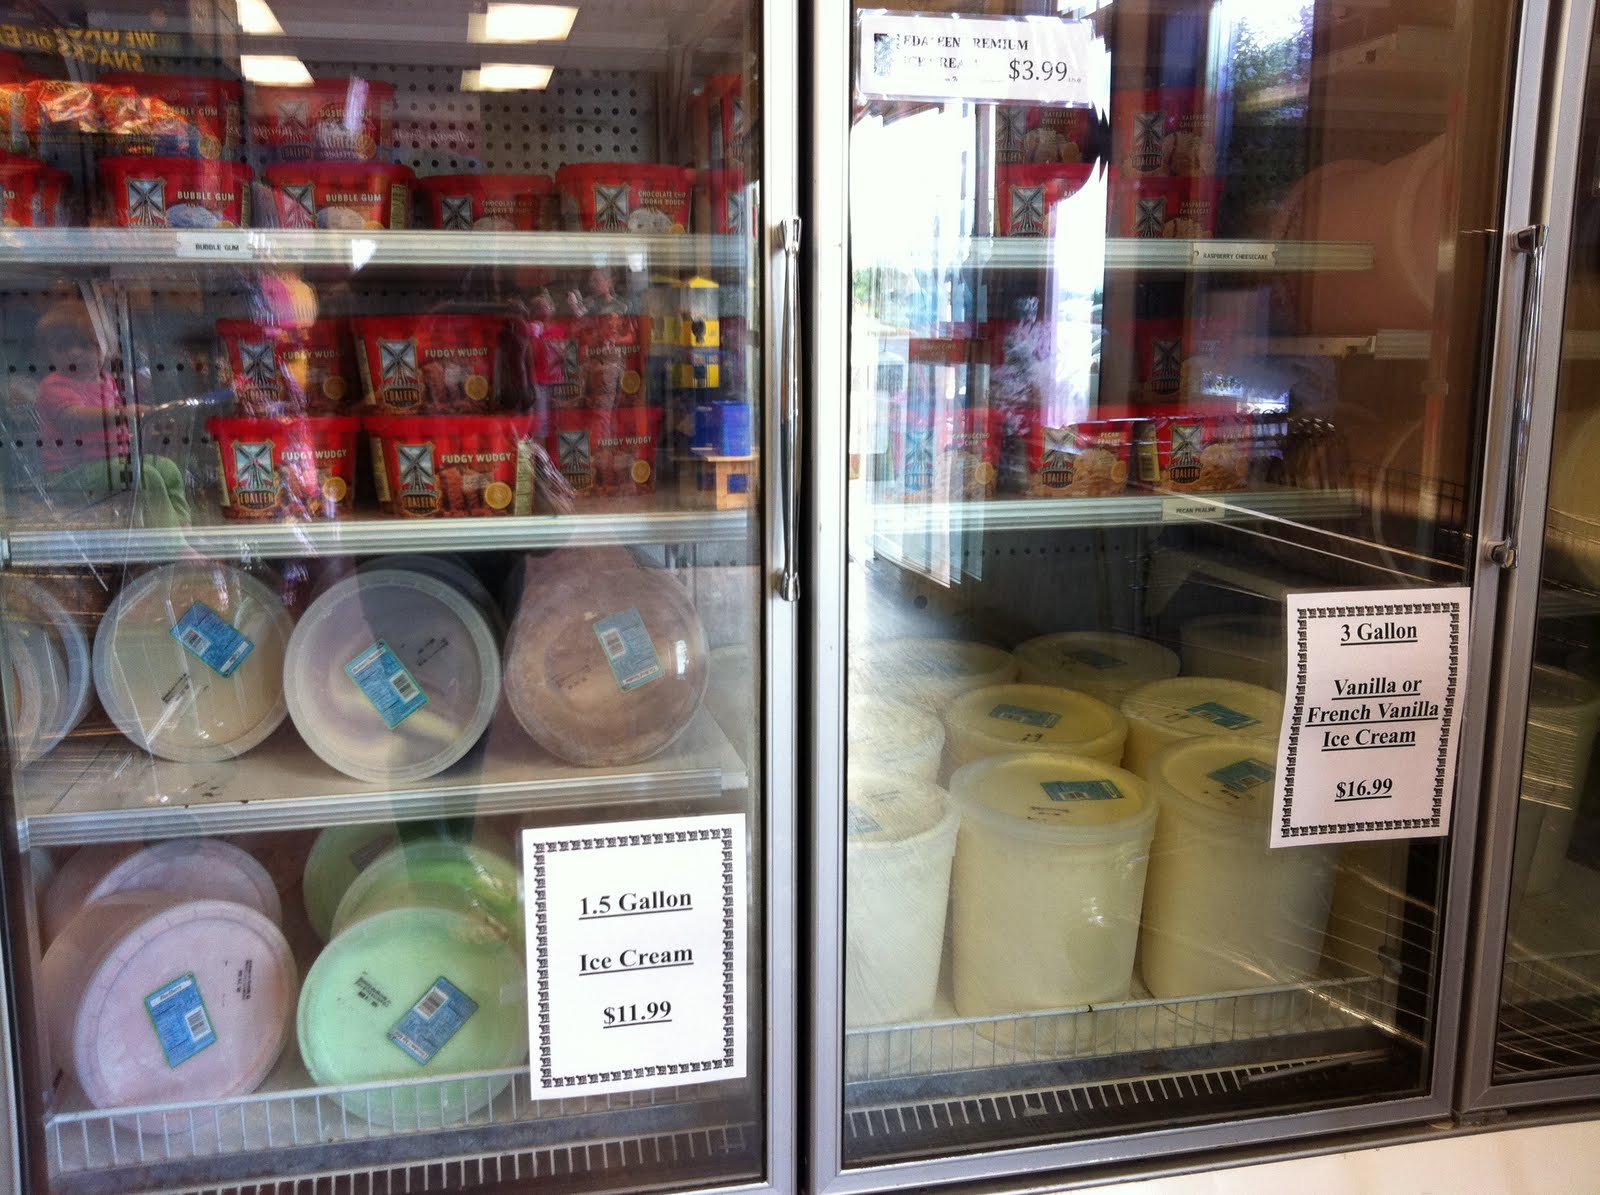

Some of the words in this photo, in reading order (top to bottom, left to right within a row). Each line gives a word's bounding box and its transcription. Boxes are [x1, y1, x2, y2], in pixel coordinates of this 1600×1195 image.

[972, 37, 1028, 51] REMIUM
[1008, 58, 1068, 82] $3.99
[177, 190, 212, 200] BUBBLE
[214, 192, 235, 201] GUM
[325, 193, 359, 202] BUBBLE
[361, 193, 382, 202] GUM
[638, 190, 672, 198] CHOCOLATE
[195, 243, 221, 251] BUBBLE
[224, 243, 239, 251] GUM
[1202, 252, 1233, 260] RASPBERRY
[425, 348, 456, 358] FUDGY
[457, 347, 488, 357] WUDGY
[281, 450, 313, 461] FUDGY
[315, 449, 347, 459] WUDGY
[441, 454, 474, 464] FUDGY
[476, 452, 512, 463] WUDGY
[1194, 506, 1216, 514] PRALINE
[1340, 624, 1351, 642] 3
[1356, 622, 1417, 641] Gallon
[1334, 677, 1396, 696] Vanilla
[1402, 678, 1422, 693] or
[1307, 704, 1371, 723] French
[1378, 701, 1439, 718] Vanilla
[1322, 731, 1350, 748] Ice
[1355, 729, 1416, 746] Cream
[1335, 778, 1393, 798] $16.99
[579, 895, 611, 916] 1.5
[618, 890, 692, 912] Gallon
[579, 953, 612, 972] Ice
[619, 948, 694, 968] Cream
[603, 1000, 672, 1025] $11.99
